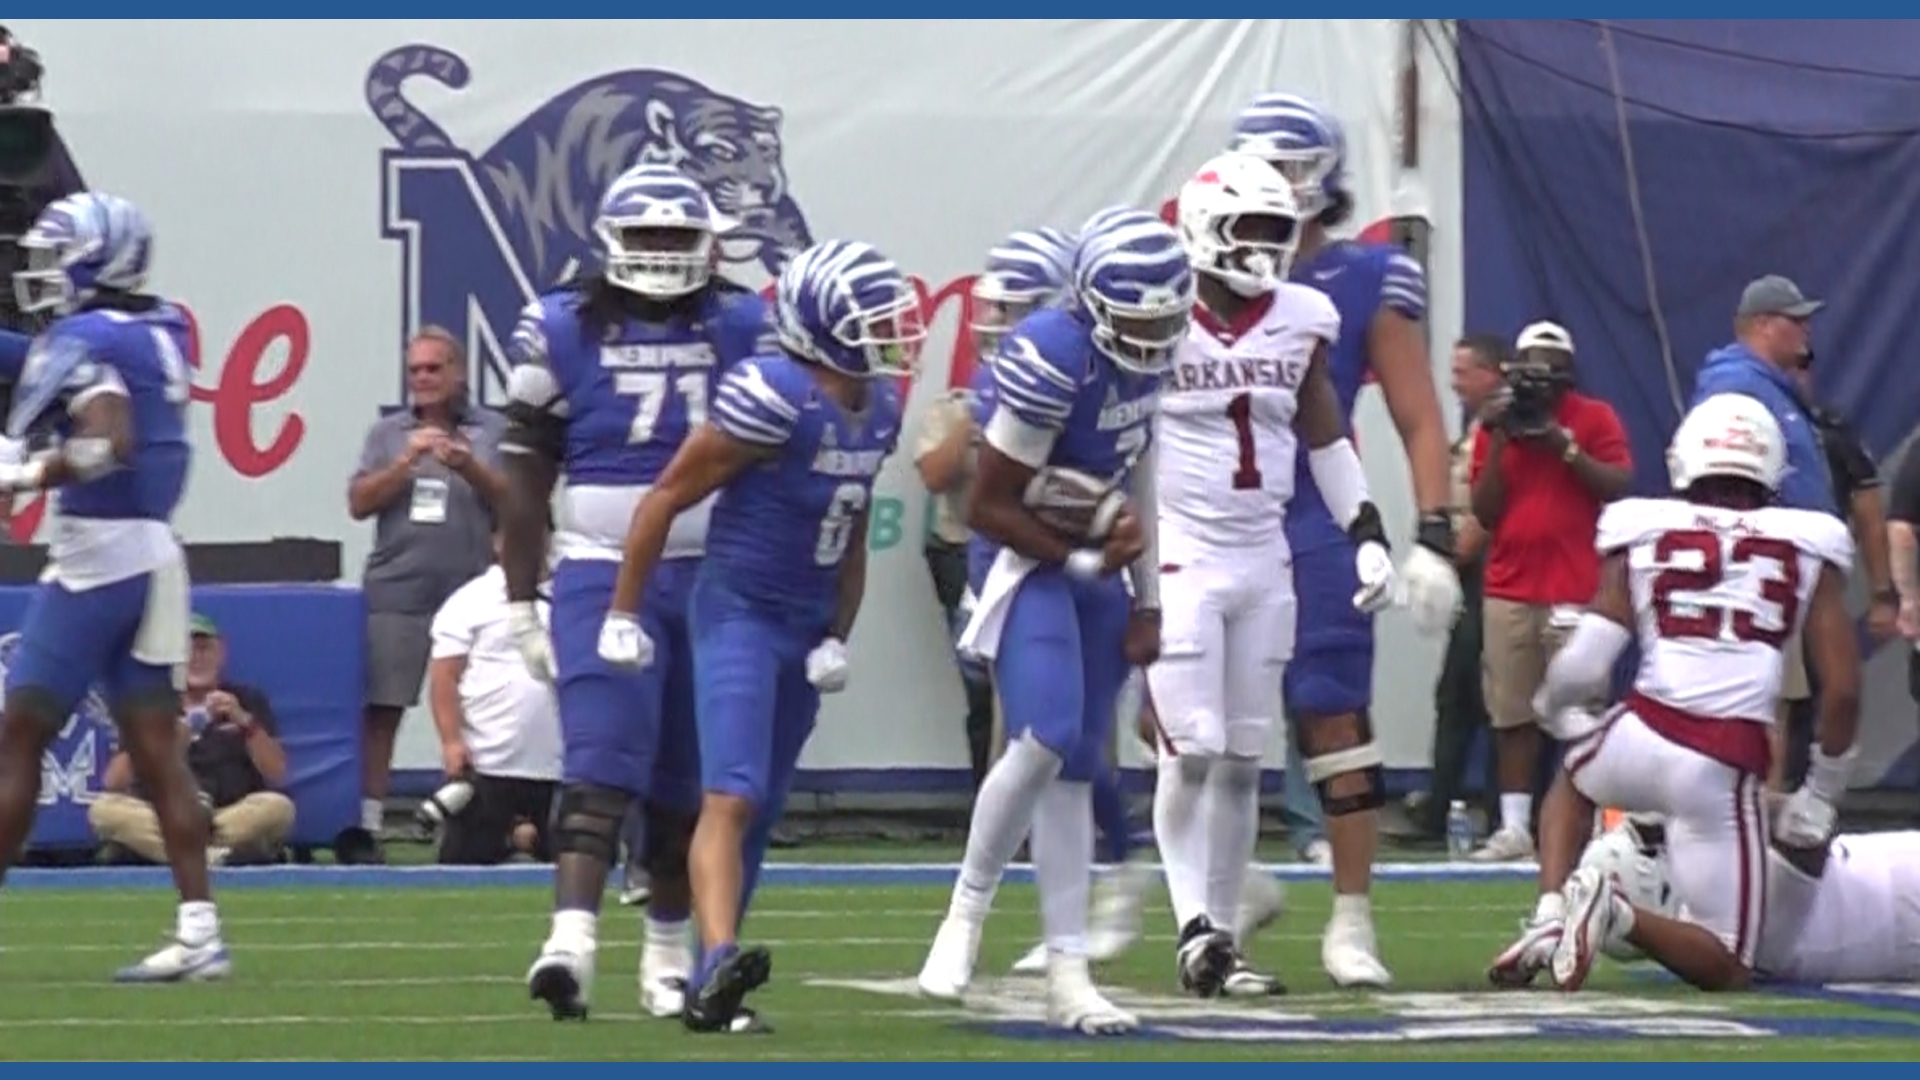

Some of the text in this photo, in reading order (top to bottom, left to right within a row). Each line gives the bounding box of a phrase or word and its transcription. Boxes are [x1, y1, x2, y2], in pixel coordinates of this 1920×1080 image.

[615, 371, 708, 443] 71
[1226, 392, 1262, 490] 1
[814, 484, 866, 565] 6
[1654, 530, 1799, 648] 23
